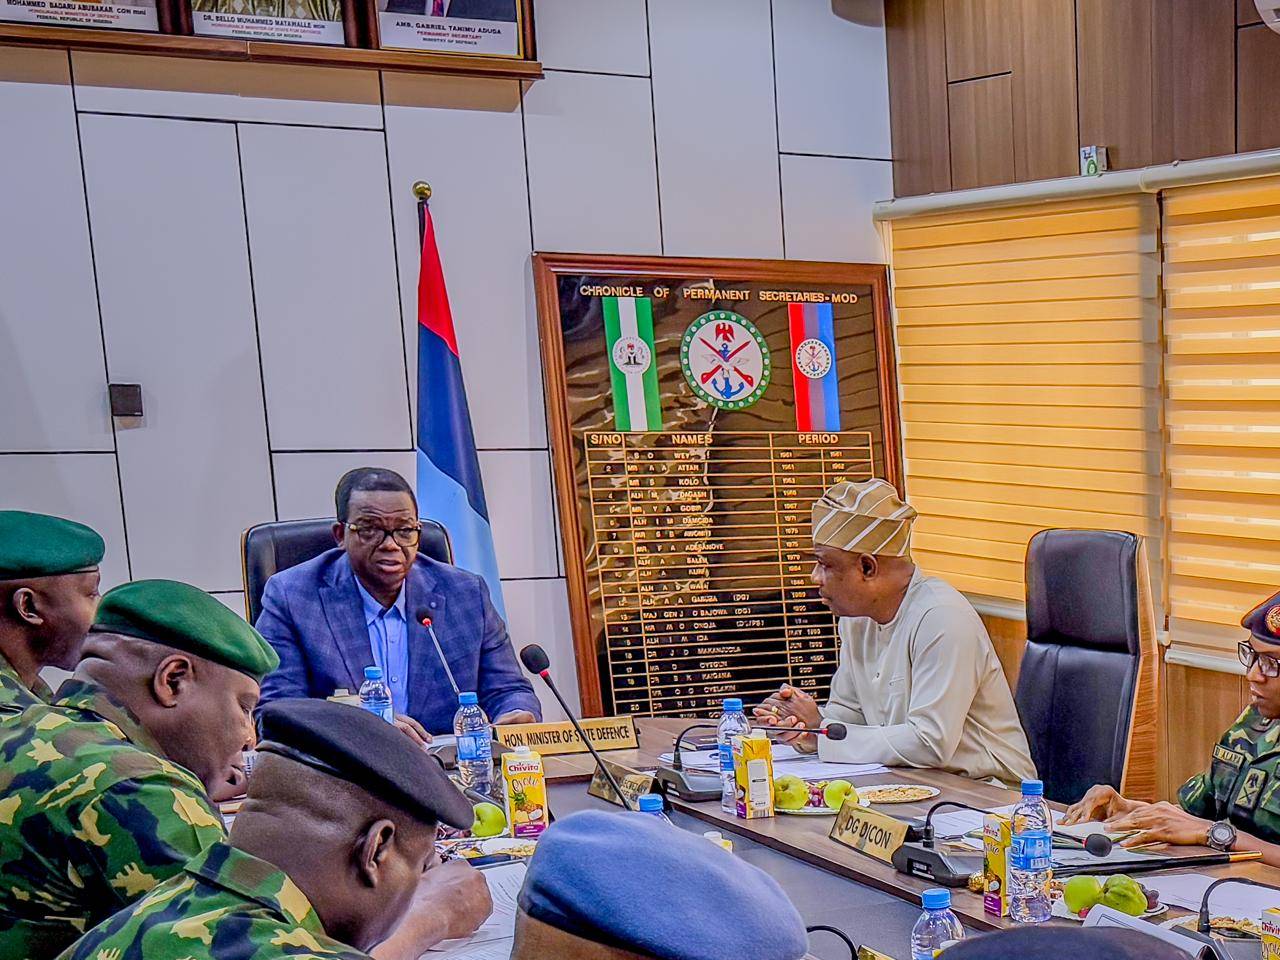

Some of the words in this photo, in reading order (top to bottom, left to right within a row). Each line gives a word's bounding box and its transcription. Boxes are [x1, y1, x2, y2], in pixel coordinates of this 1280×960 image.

[579, 285, 644, 298] CHRONICLE
[653, 286, 670, 299] OF
[683, 288, 750, 301] PERMANENT
[590, 434, 622, 445] S/NO
[671, 434, 713, 445] NAMES
[798, 434, 839, 445] PERIOD
[526, 730, 561, 746] MINISTER
[562, 729, 574, 743] OF
[574, 728, 596, 742] SATE
[597, 725, 630, 740] DEFENCE
[844, 815, 861, 834] DG
[859, 821, 892, 849] DICON
